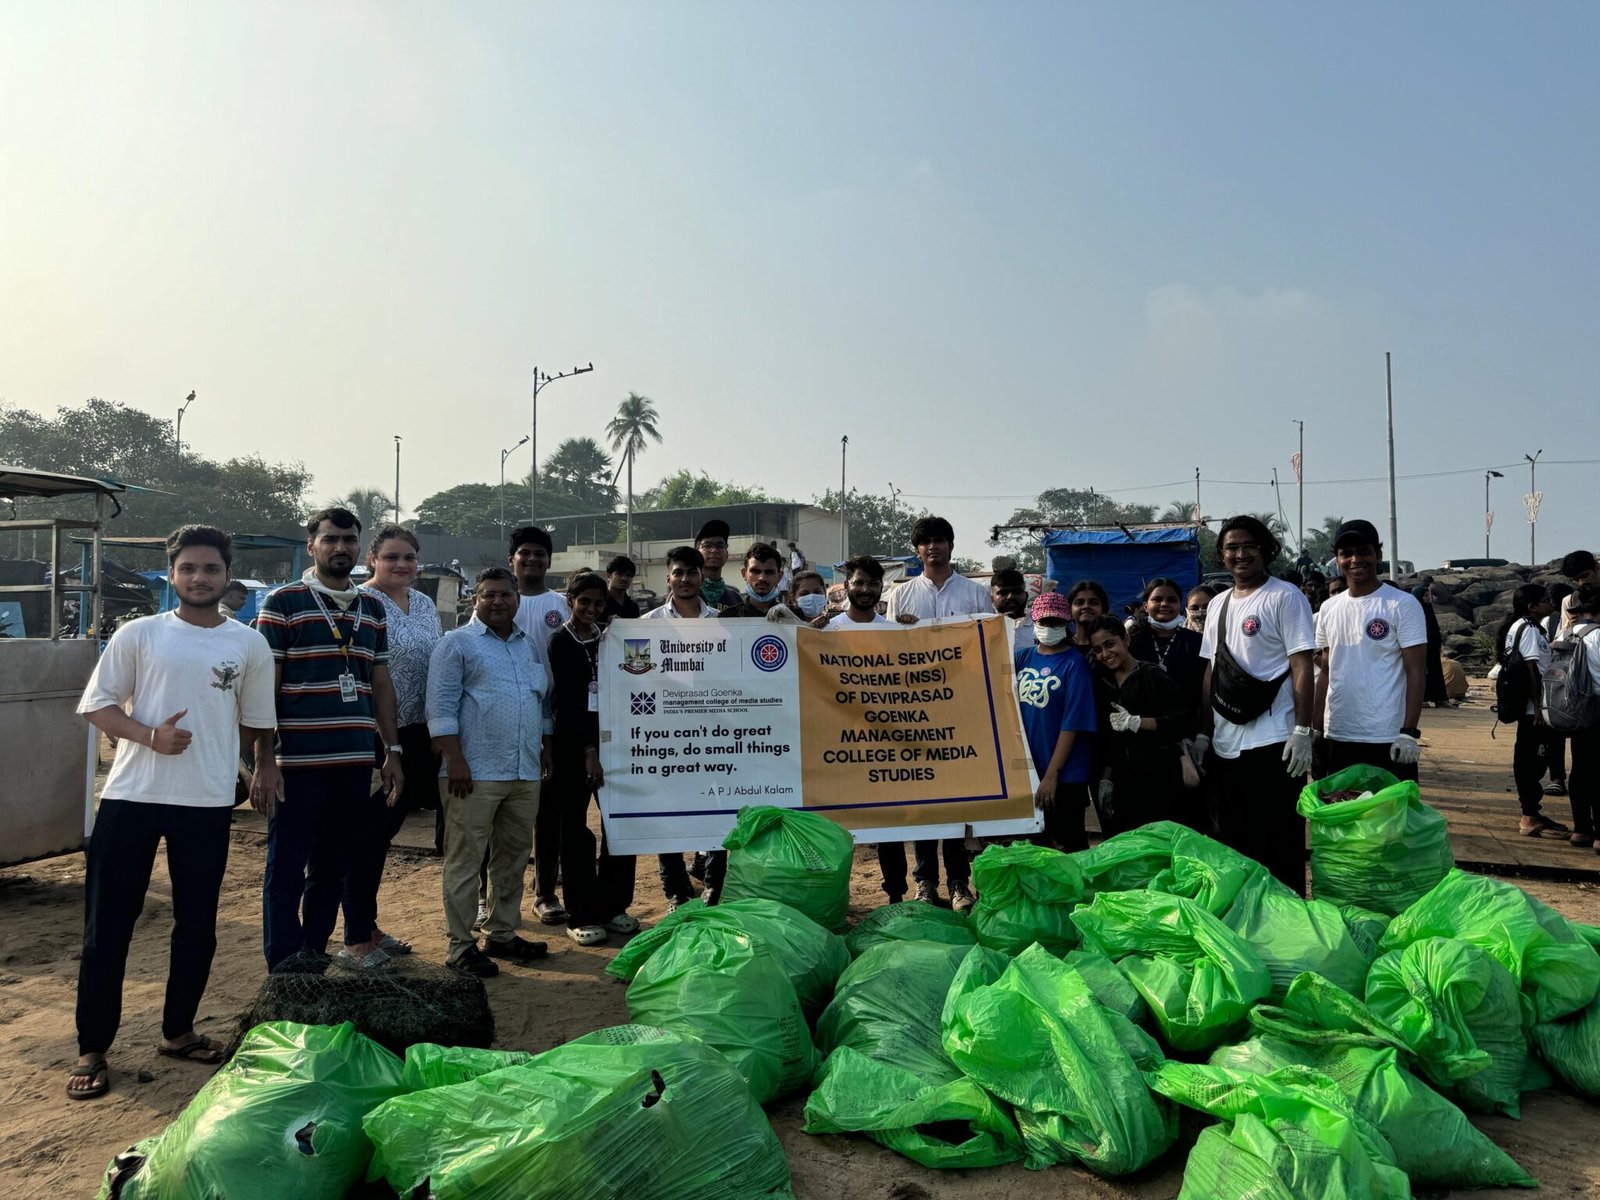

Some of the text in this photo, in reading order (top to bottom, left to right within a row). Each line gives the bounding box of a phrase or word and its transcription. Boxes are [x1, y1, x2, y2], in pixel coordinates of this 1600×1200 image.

[660, 639, 726, 654] University of
[820, 647, 962, 667] NATIONAL SERVICE
[660, 658, 704, 673] Mumbai
[840, 668, 946, 687] SCHEME (NSS)
[663, 688, 742, 698] Deviprasad Goenka
[836, 688, 954, 704] OF DEVIPRASAD
[864, 710, 929, 723] GOENKA
[631, 724, 771, 742] If you can't do great
[840, 727, 955, 743] MANAGEMENT
[631, 740, 790, 759] things, do small things
[823, 745, 977, 764] COLLEGE OF MEDIA
[631, 762, 738, 777] in a great way.
[868, 768, 935, 782] STUDIES
[708, 787, 715, 796] A
[718, 787, 724, 796] P
[727, 787, 732, 795] J
[734, 786, 762, 795] Abdul
[765, 785, 793, 794] Kalam
